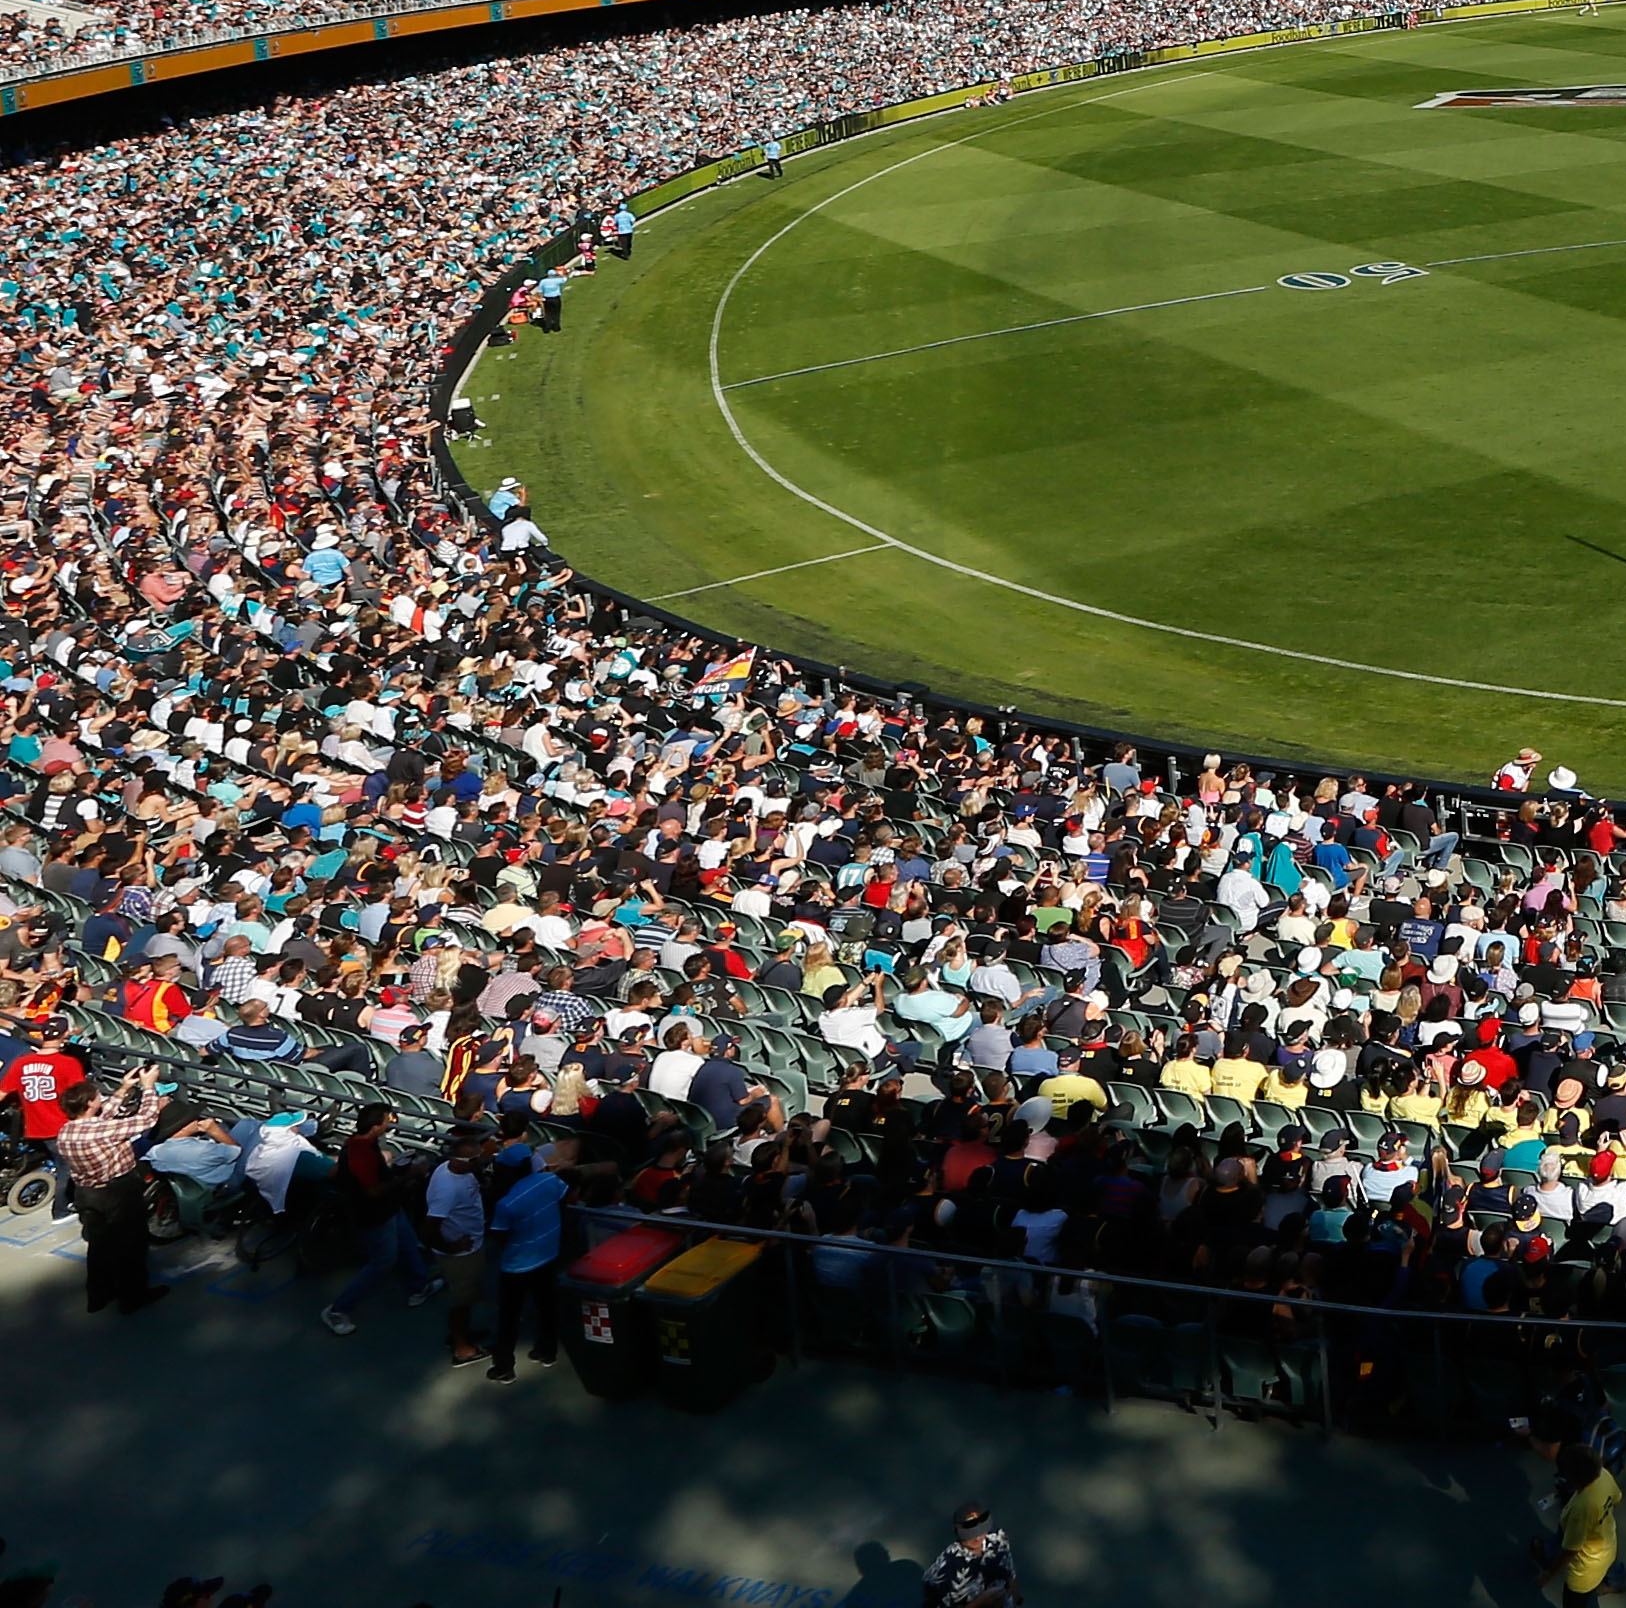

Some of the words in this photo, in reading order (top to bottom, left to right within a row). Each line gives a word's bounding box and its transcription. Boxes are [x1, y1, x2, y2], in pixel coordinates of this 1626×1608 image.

[275, 993, 286, 1014] 7
[21, 1076, 57, 1102] 32
[637, 1563, 833, 1608] WALKWAYS
